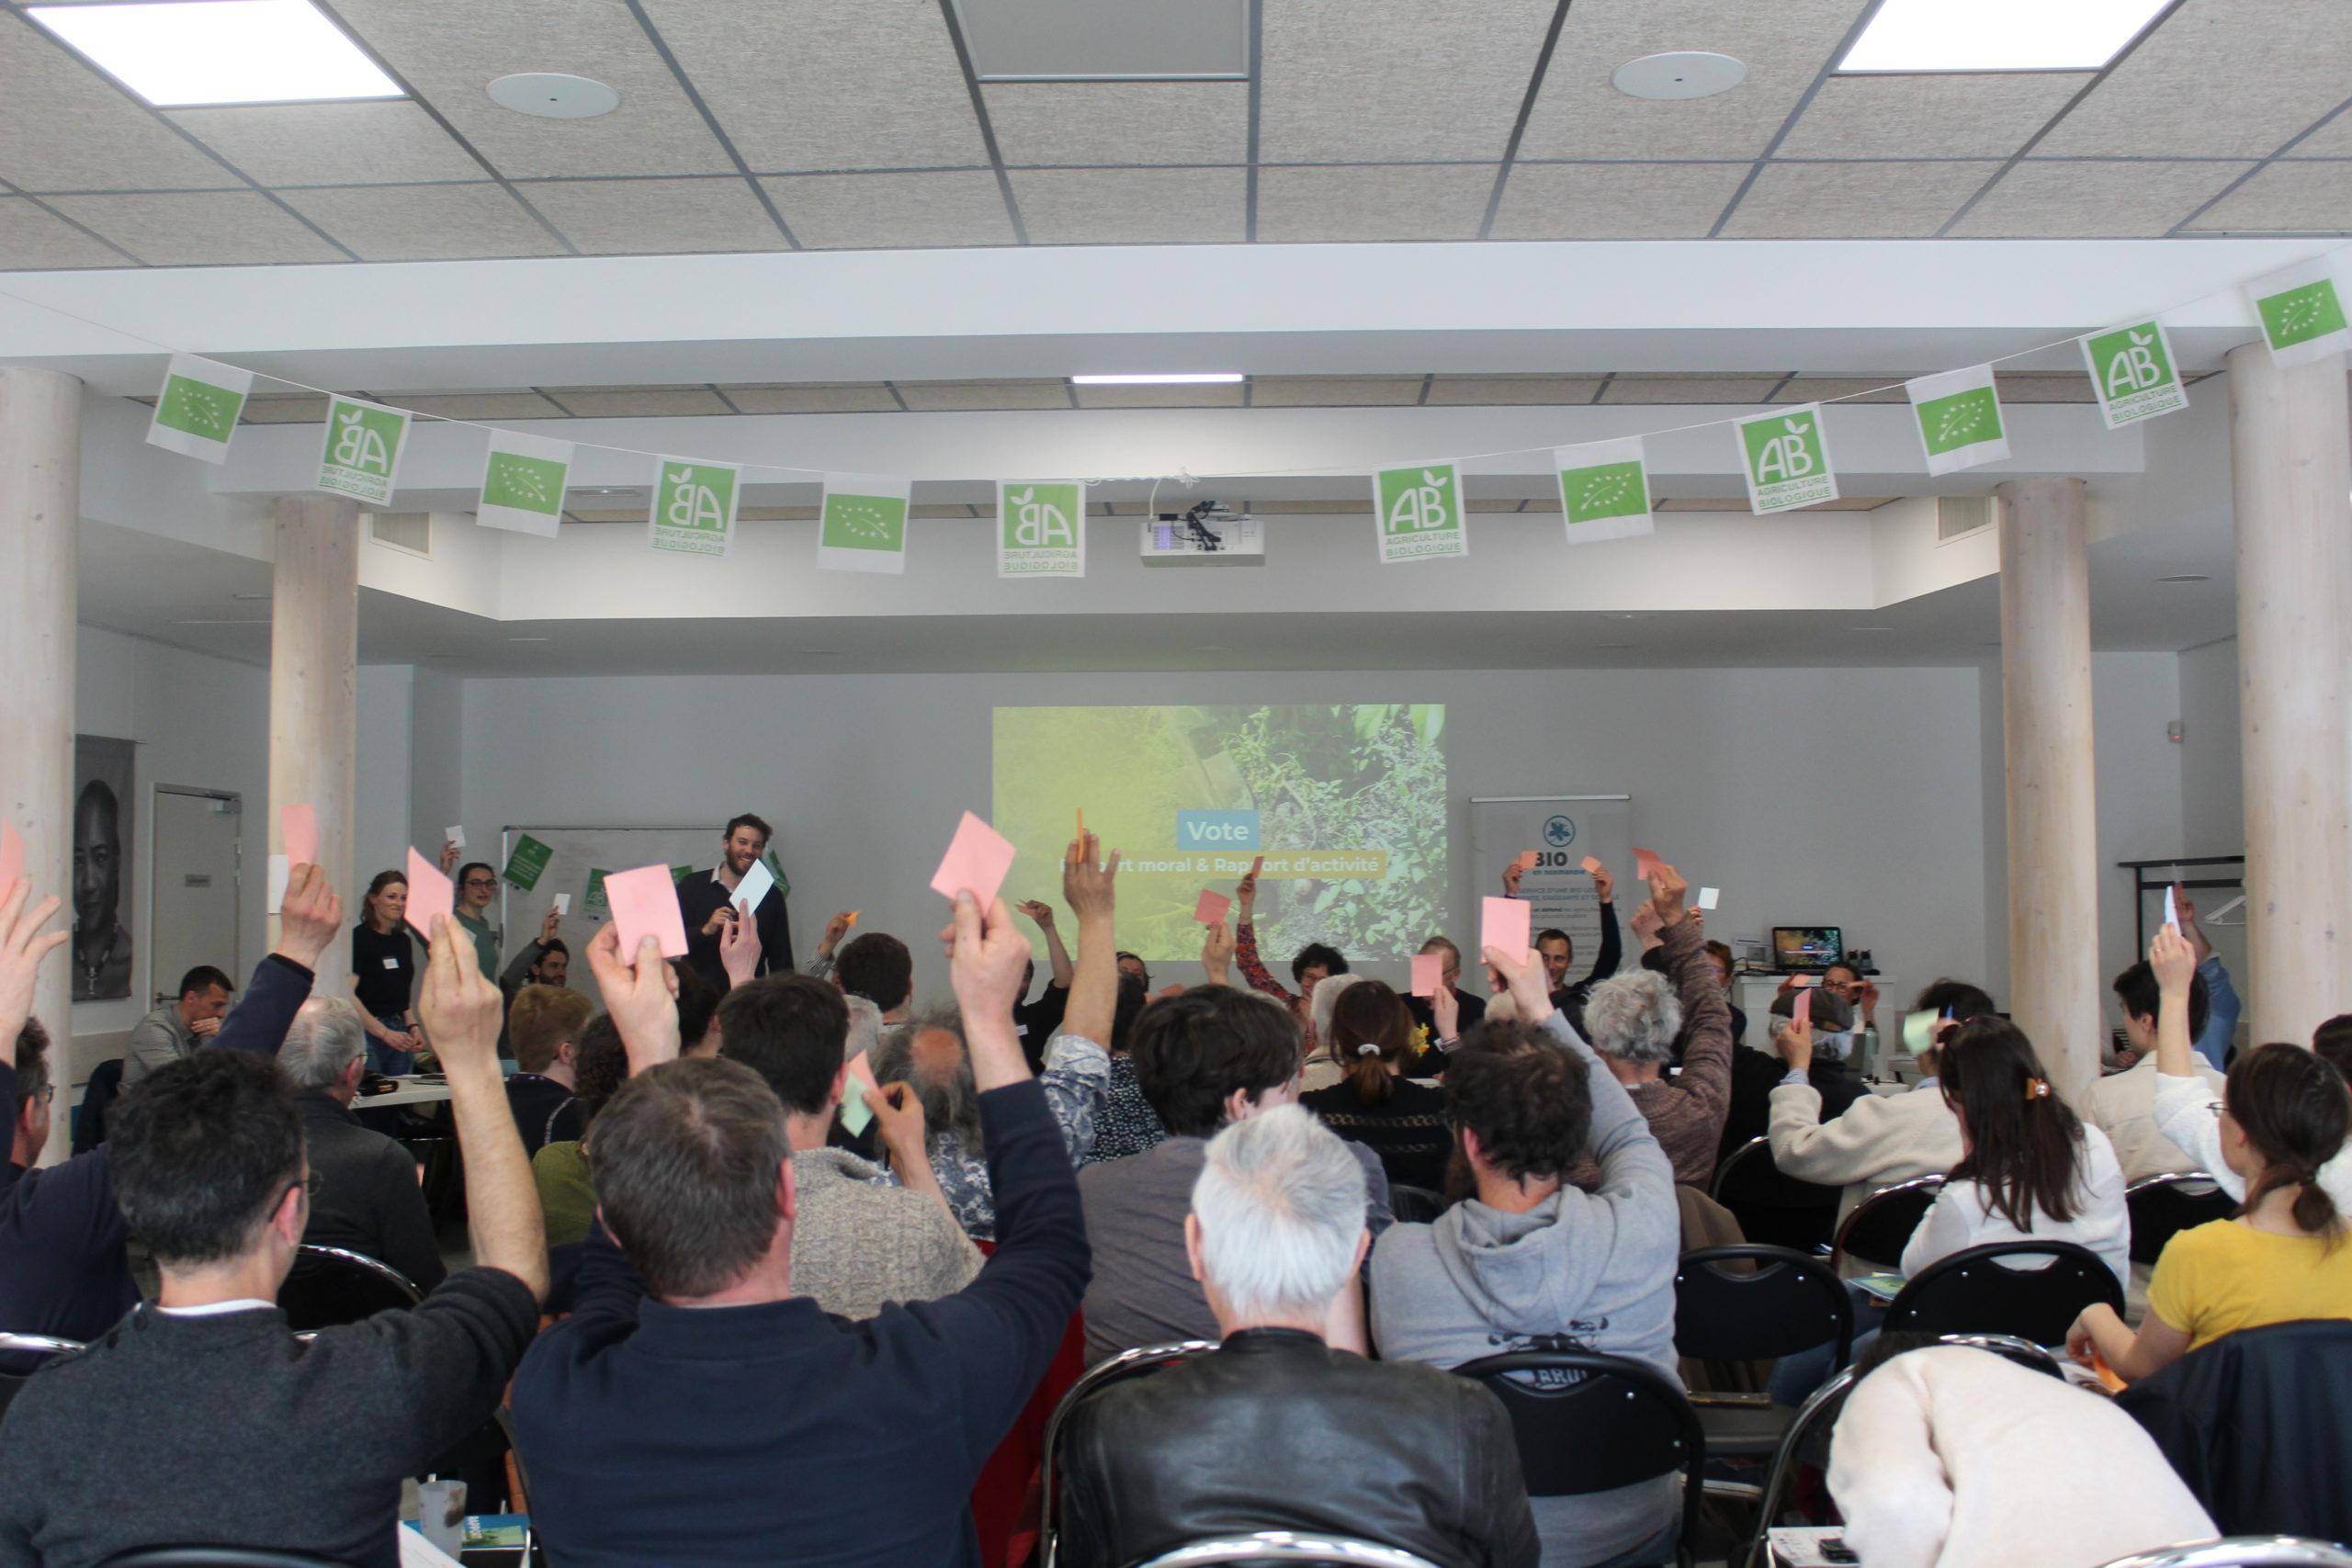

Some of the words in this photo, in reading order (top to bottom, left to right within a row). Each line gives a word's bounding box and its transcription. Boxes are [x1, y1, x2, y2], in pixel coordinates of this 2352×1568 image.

[2107, 345, 2161, 397] AB
[2108, 384, 2177, 412] AGRICULTURE
[1757, 434, 1814, 483] AB
[1757, 476, 1828, 496] AGRICULTURE
[1758, 486, 1832, 507] BIOLOGIQUE
[1388, 486, 1447, 533] AB
[1385, 531, 1460, 547] AGRICULTURE
[1385, 542, 1462, 557] BIOLOGIQUE
[1186, 820, 1250, 841] Vote
[1138, 857, 1192, 873] moral
[1196, 858, 1209, 873] &
[1215, 858, 1289, 875] Raport
[1294, 855, 1379, 873] d'activité
